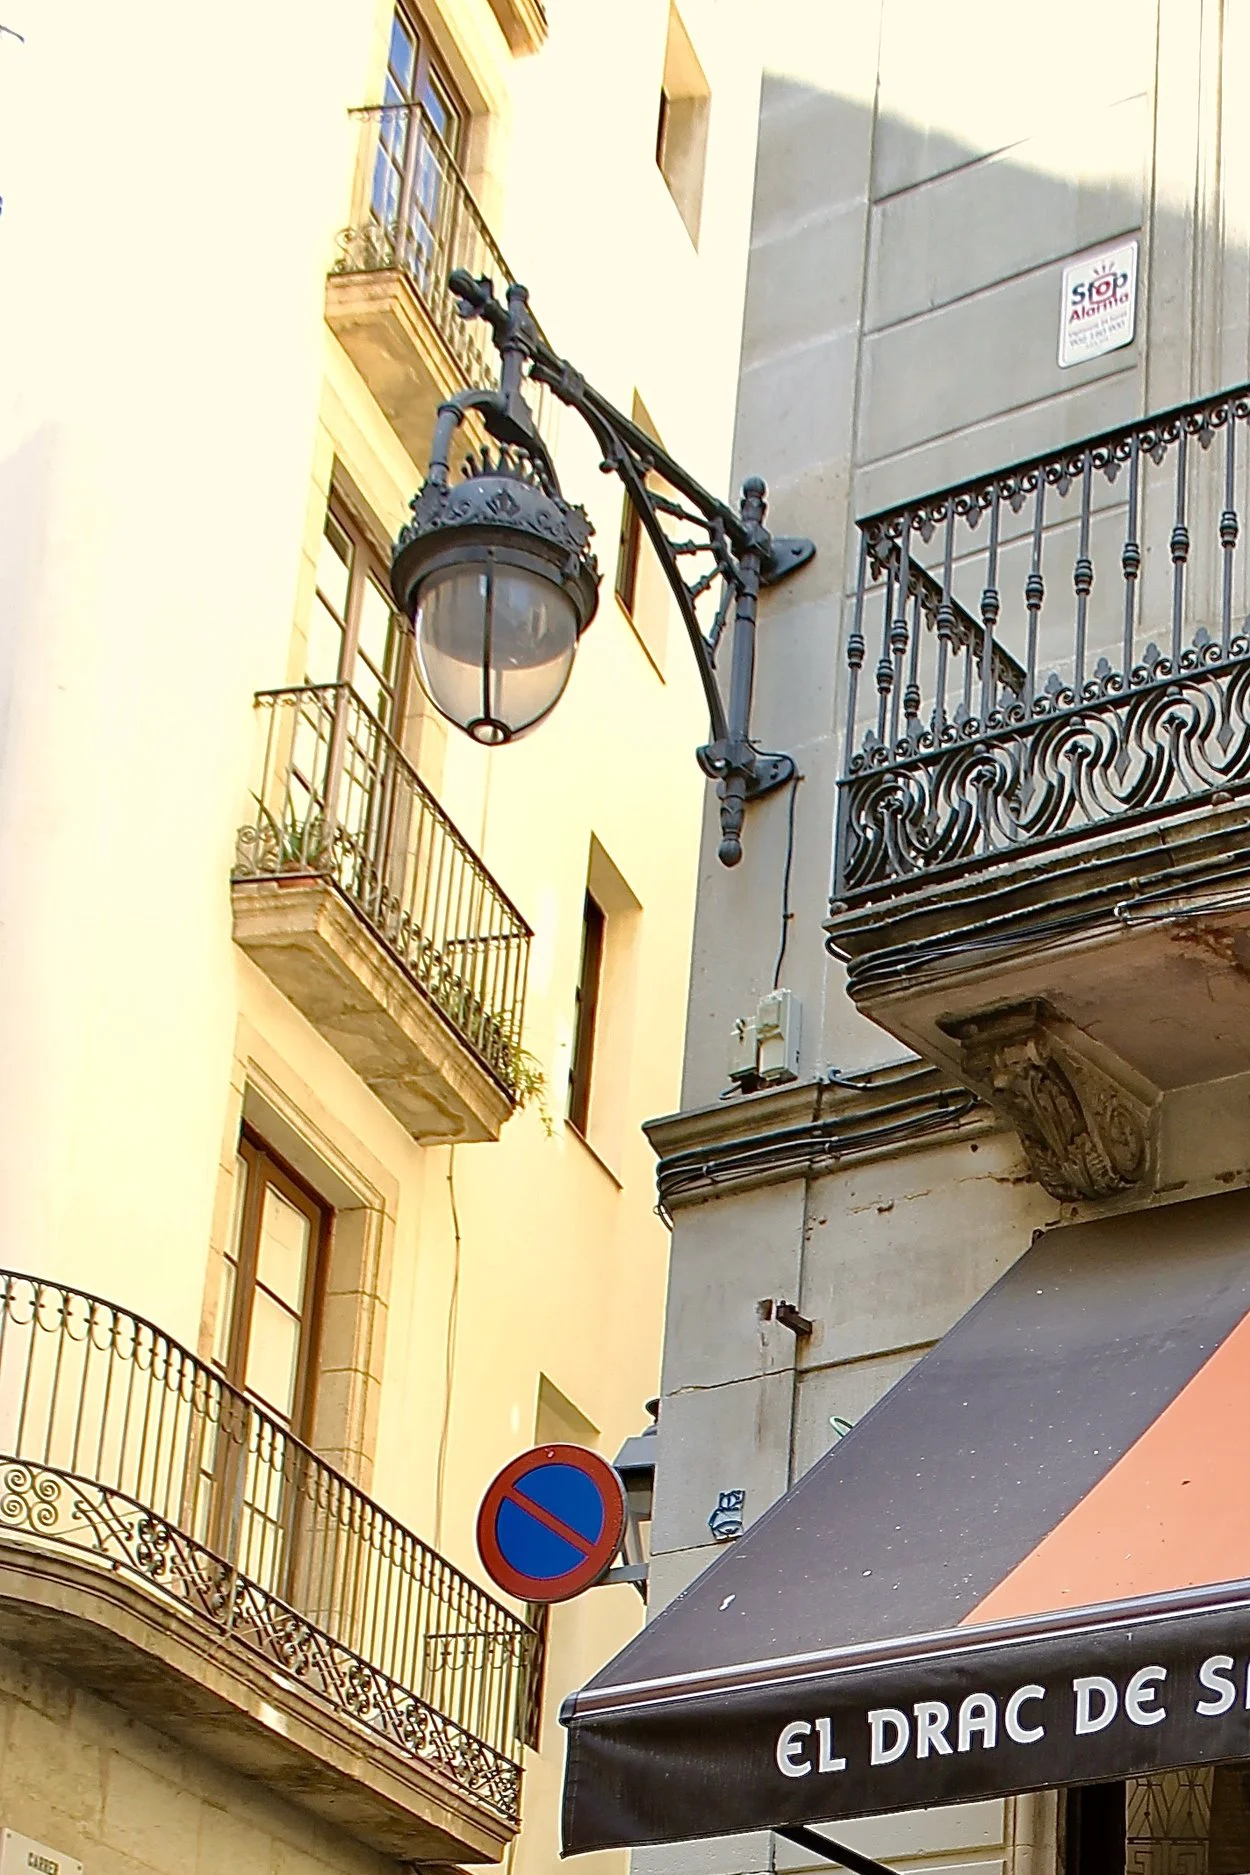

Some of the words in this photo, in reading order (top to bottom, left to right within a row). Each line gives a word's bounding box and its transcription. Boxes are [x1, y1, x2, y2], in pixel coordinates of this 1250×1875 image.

[1068, 293, 1129, 324] Alarma
[776, 1715, 847, 1778] EL
[868, 1684, 1046, 1768] DRAC
[1073, 1665, 1168, 1737] DE
